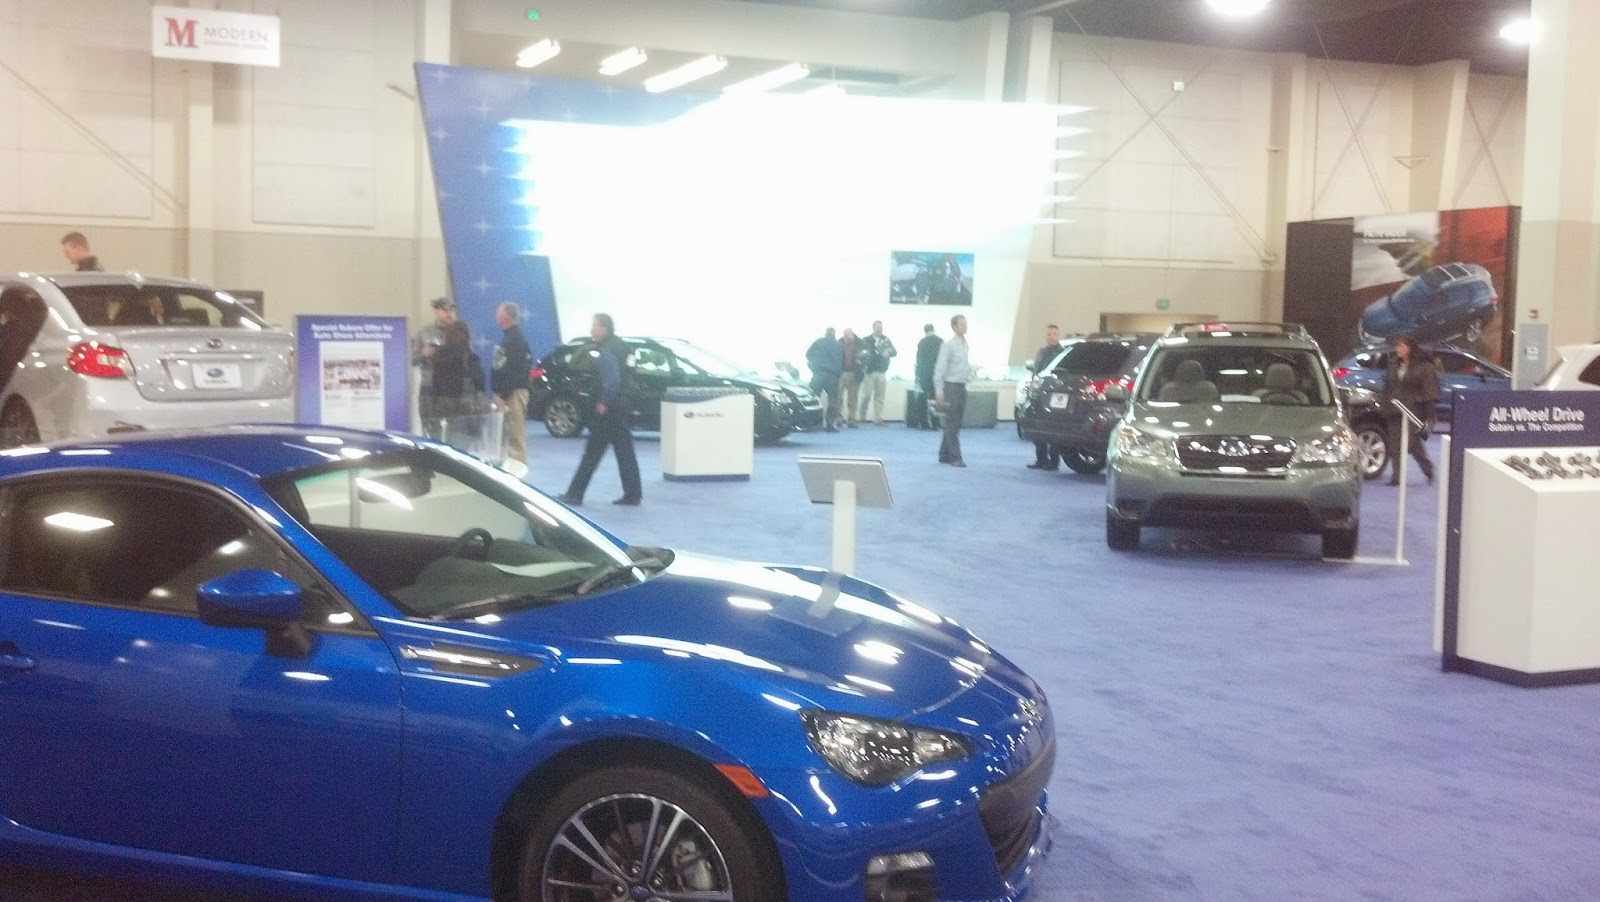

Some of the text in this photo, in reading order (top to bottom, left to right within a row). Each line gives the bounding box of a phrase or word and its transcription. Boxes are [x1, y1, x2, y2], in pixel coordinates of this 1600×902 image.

[165, 18, 199, 48] M
[204, 27, 267, 43] MODERN
[1489, 407, 1585, 421] All-Wheel Drive
[1488, 422, 1584, 432] Subaru vs. The Competition
